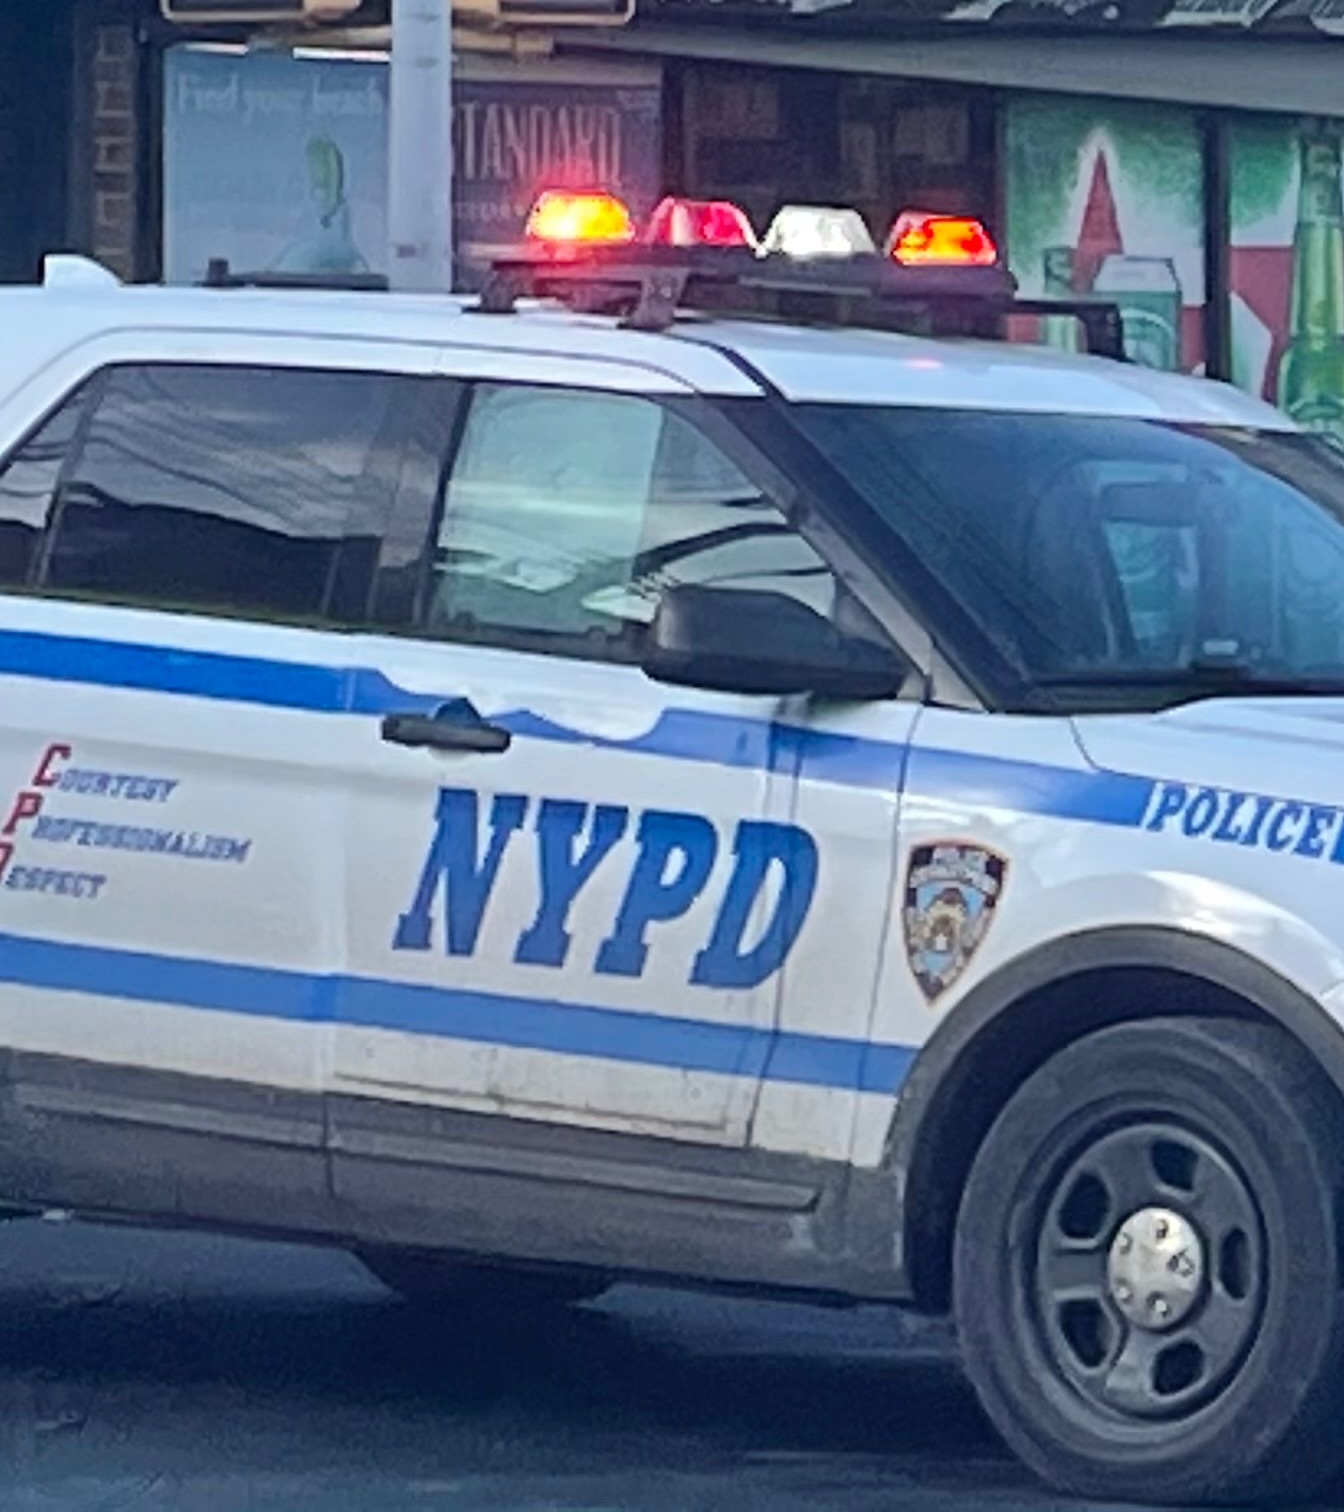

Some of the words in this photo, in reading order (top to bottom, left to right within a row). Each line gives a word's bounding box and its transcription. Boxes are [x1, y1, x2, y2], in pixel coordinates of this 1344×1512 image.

[452, 100, 624, 188] TANDARD
[1146, 782, 1339, 859] POLICE
[391, 785, 820, 990] NYPD
